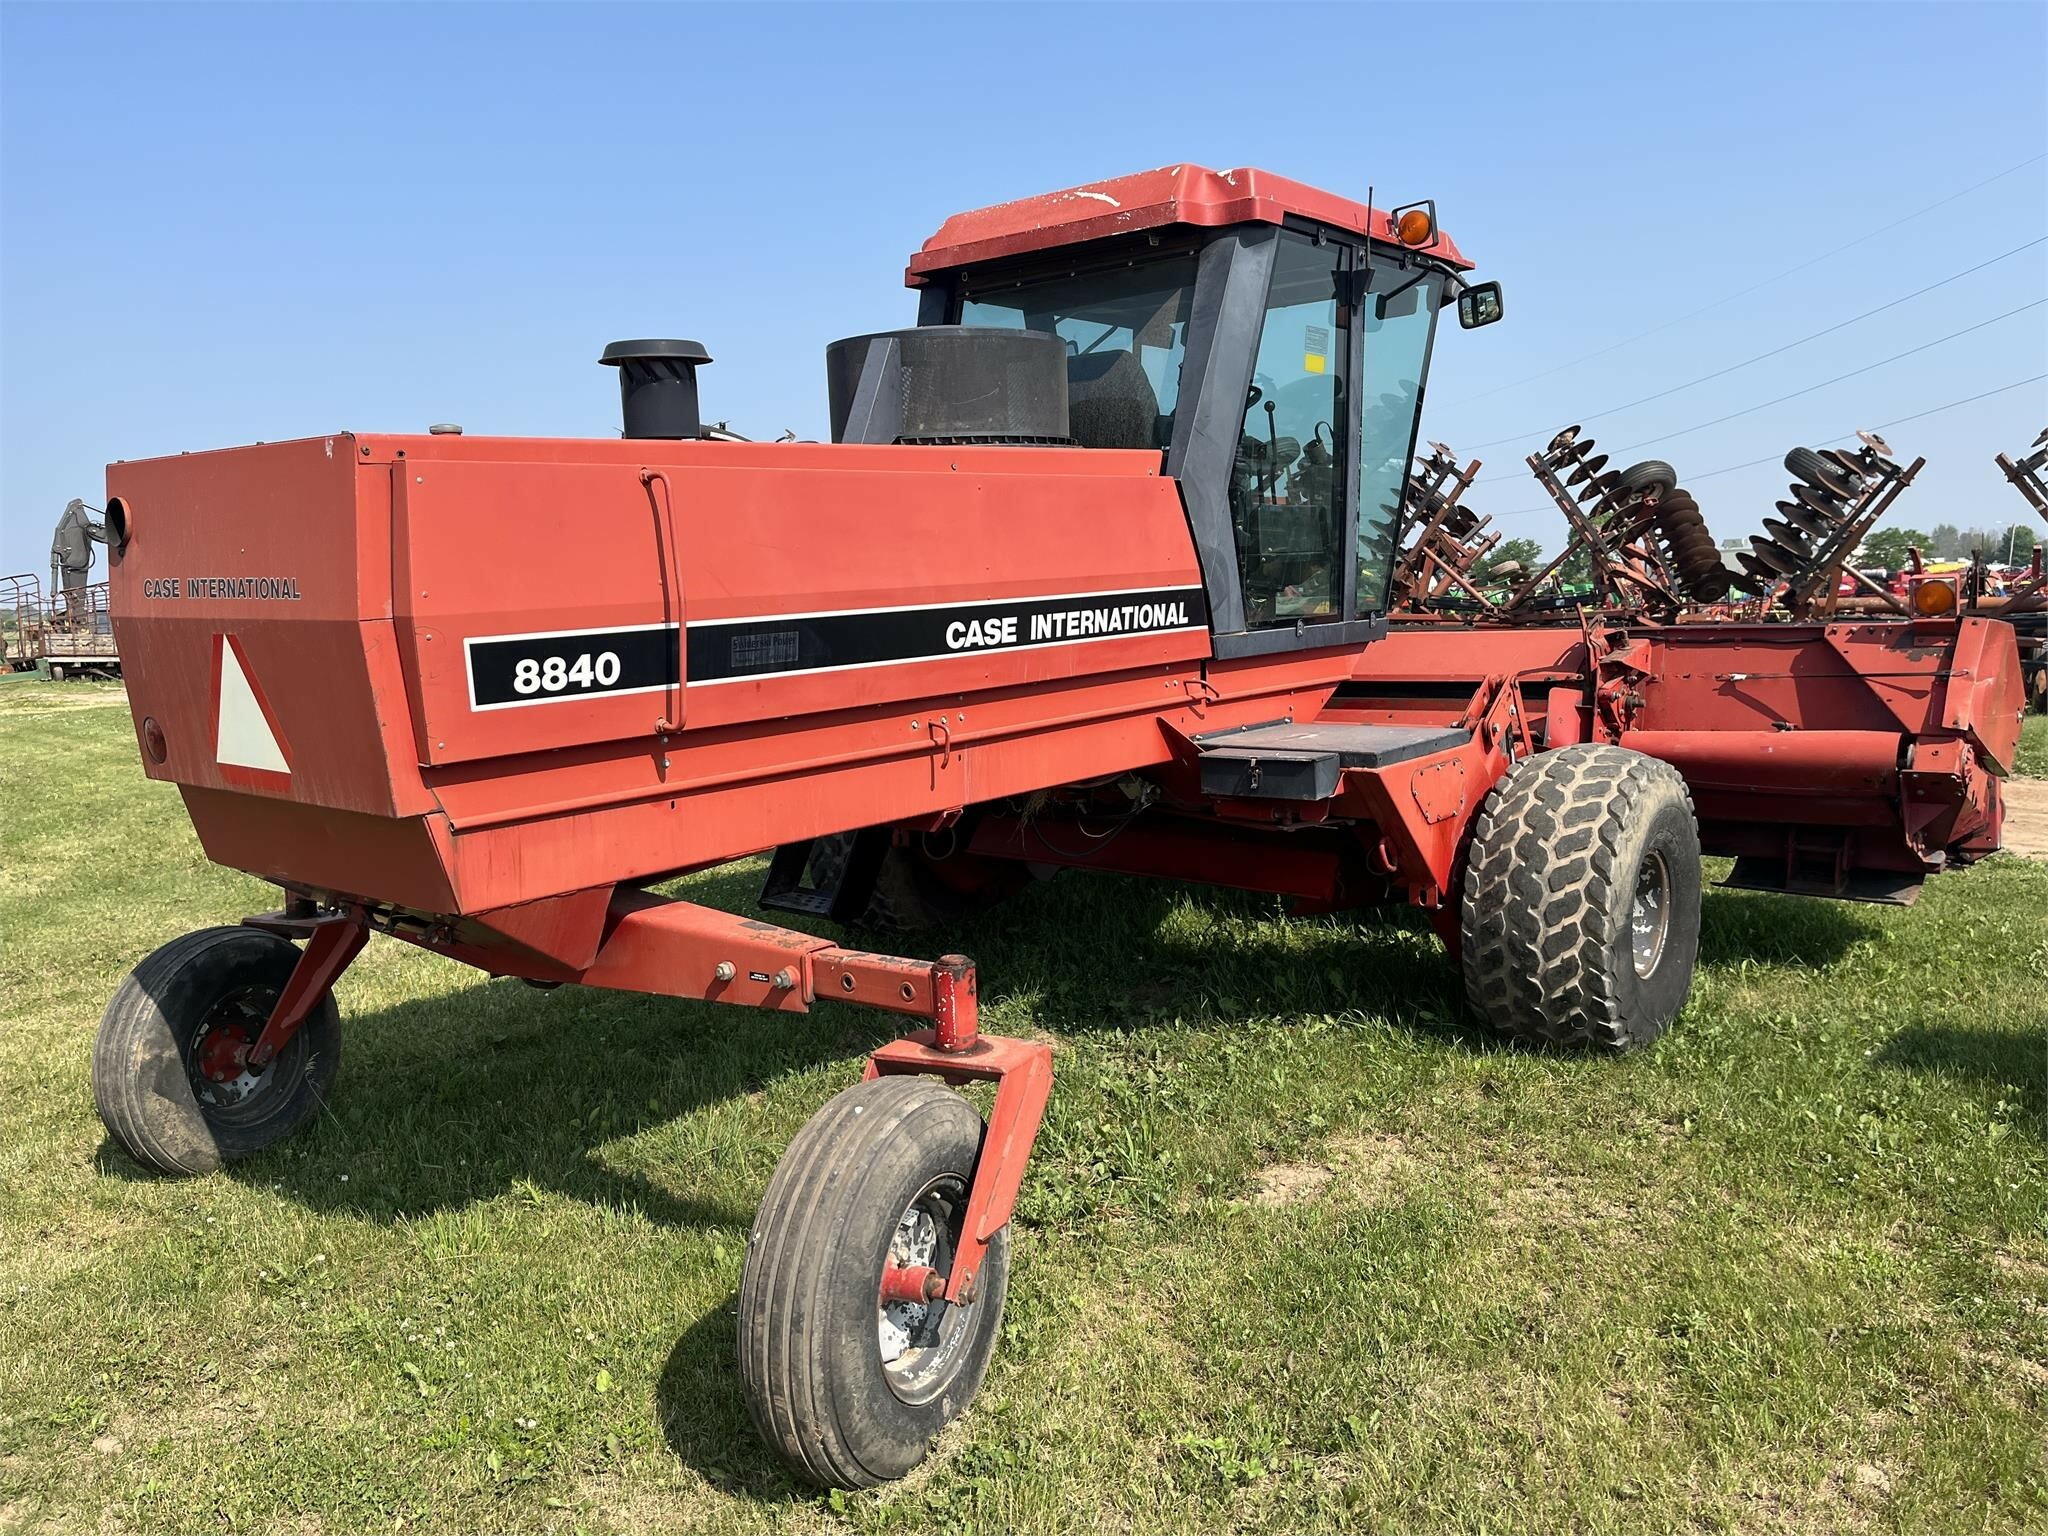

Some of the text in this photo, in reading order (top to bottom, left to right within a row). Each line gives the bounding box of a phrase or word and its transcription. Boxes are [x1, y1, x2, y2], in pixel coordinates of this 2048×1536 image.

[144, 578, 300, 600] CASE INTERNATIONAL
[946, 602, 1189, 649] CASE INTERNATIONAL
[513, 652, 621, 694] 8840
